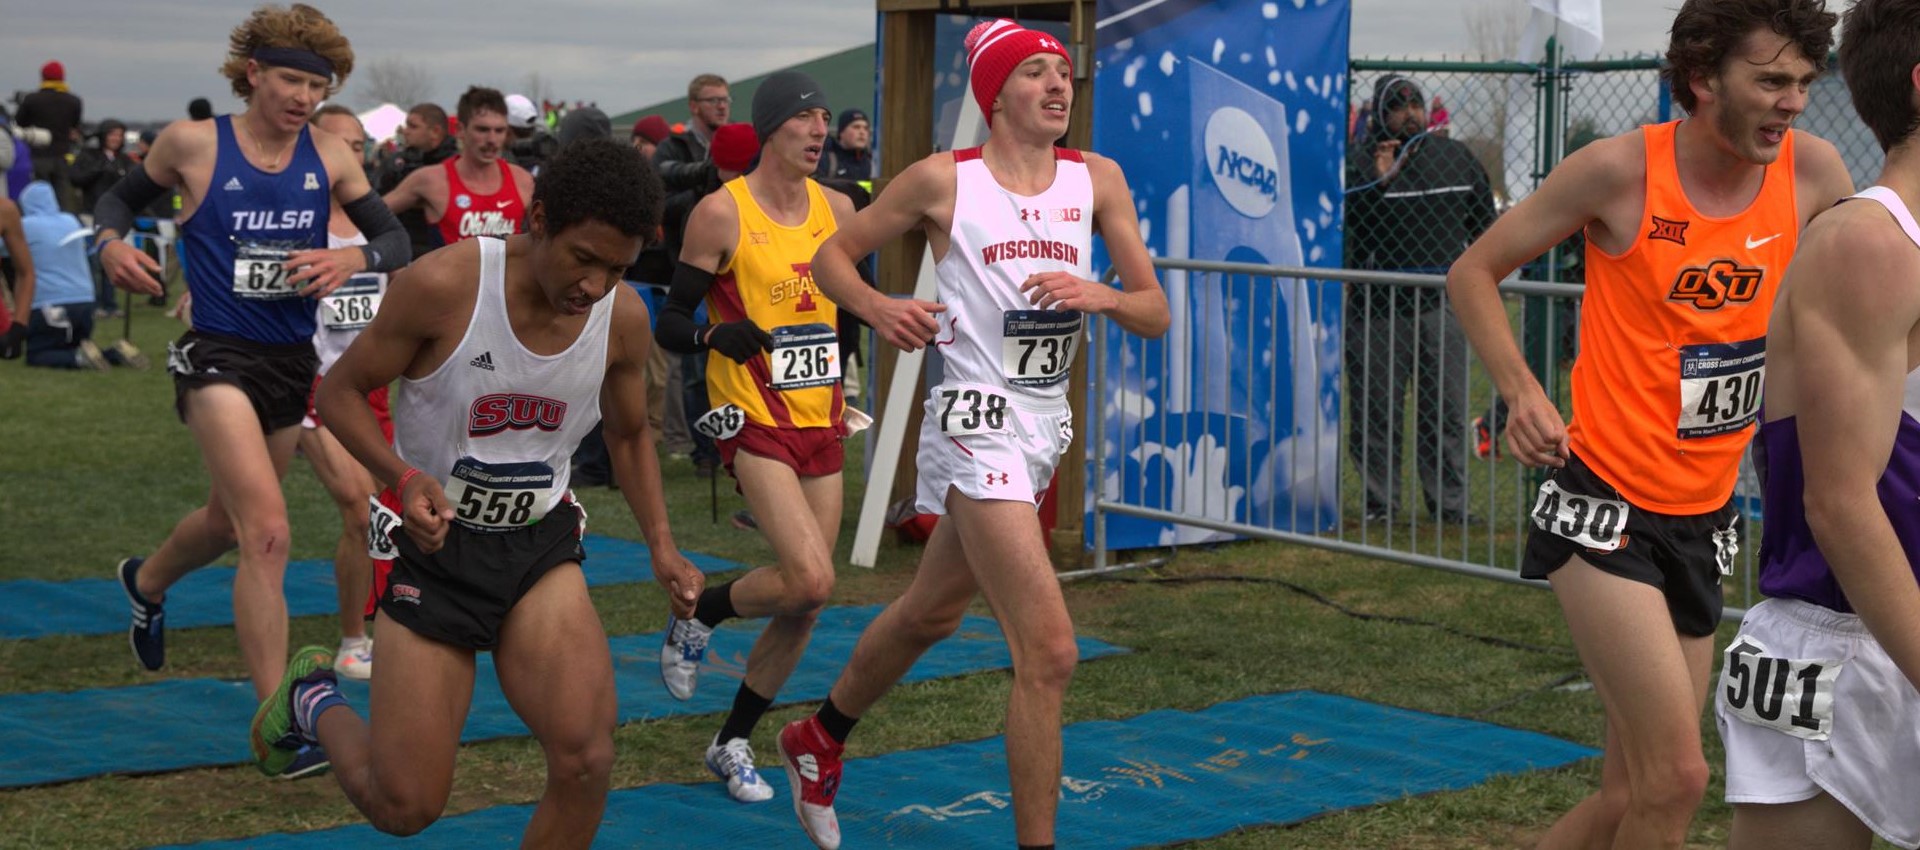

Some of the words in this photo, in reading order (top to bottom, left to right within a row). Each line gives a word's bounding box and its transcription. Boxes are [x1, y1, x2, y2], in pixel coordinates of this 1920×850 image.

[1216, 145, 1277, 203] NCAA
[232, 210, 315, 230] TULSA
[981, 240, 1078, 266] WISCONSIN
[1667, 258, 1765, 311] OSU
[332, 296, 374, 323] 368
[470, 360, 495, 371] adidas
[782, 346, 829, 380] 236
[1018, 336, 1072, 375] 738
[1698, 360, 1719, 369] CROSS
[1719, 358, 1742, 368] COUNTRY
[468, 393, 568, 438] SUU
[941, 389, 1007, 432] 738
[1697, 371, 1760, 423] 430
[456, 484, 536, 525] 558
[1536, 490, 1620, 542] 430
[1727, 642, 1823, 731] 501
